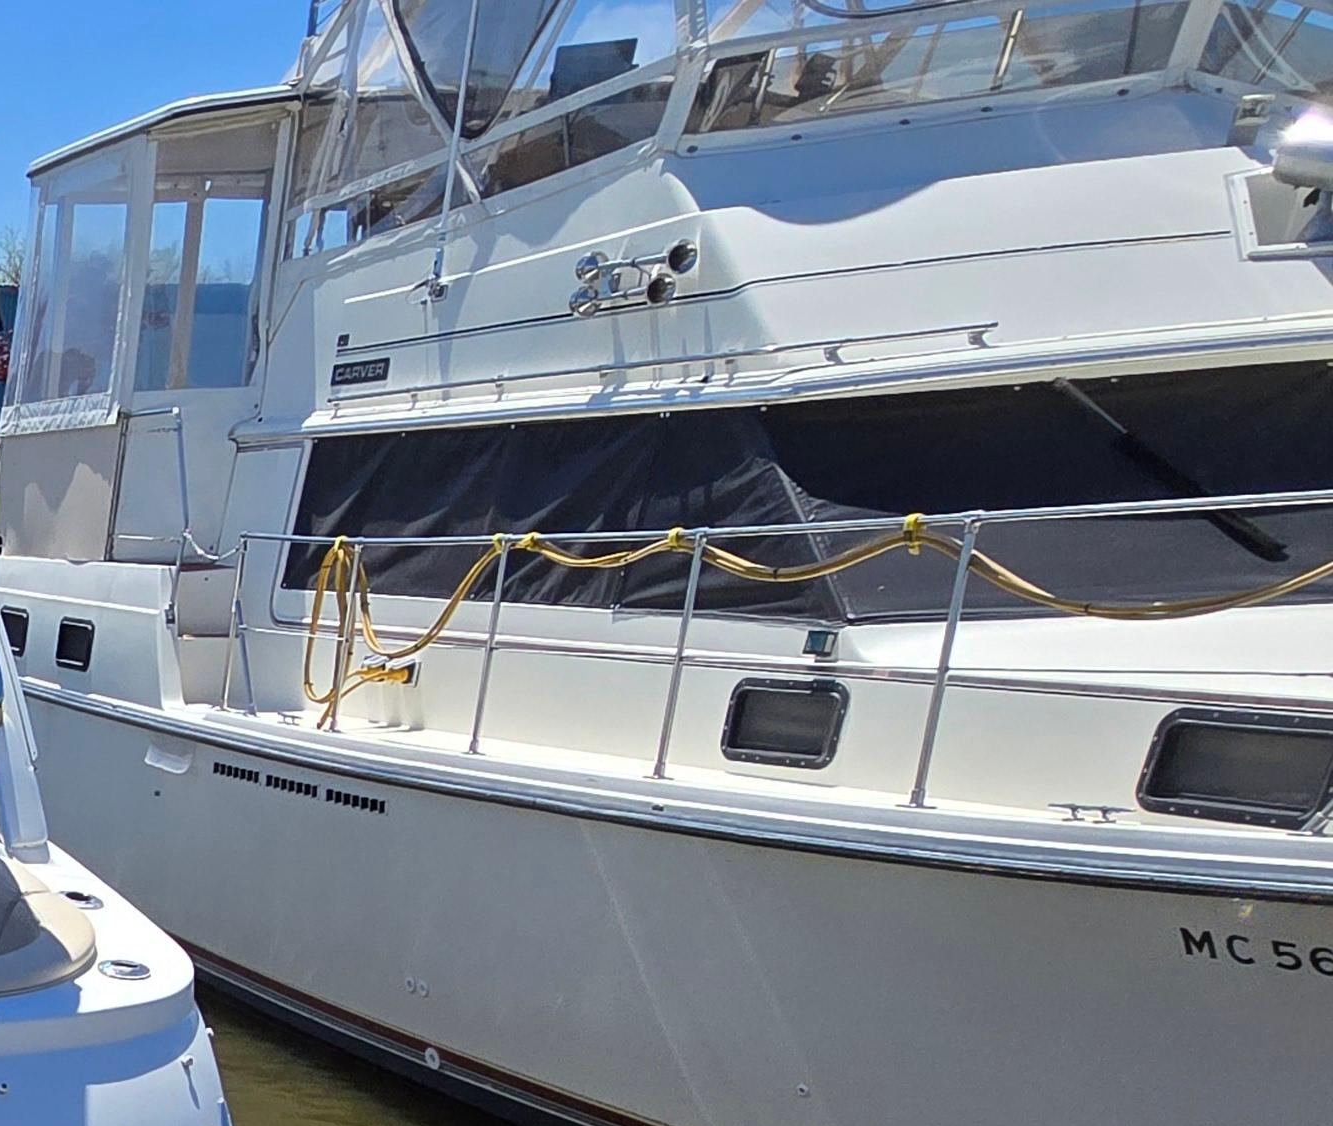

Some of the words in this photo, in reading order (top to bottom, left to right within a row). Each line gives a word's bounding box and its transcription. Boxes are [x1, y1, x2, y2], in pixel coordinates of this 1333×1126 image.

[335, 362, 385, 381] CARVER
[1180, 927, 1255, 964] MC
[1271, 940, 1333, 976] 56
